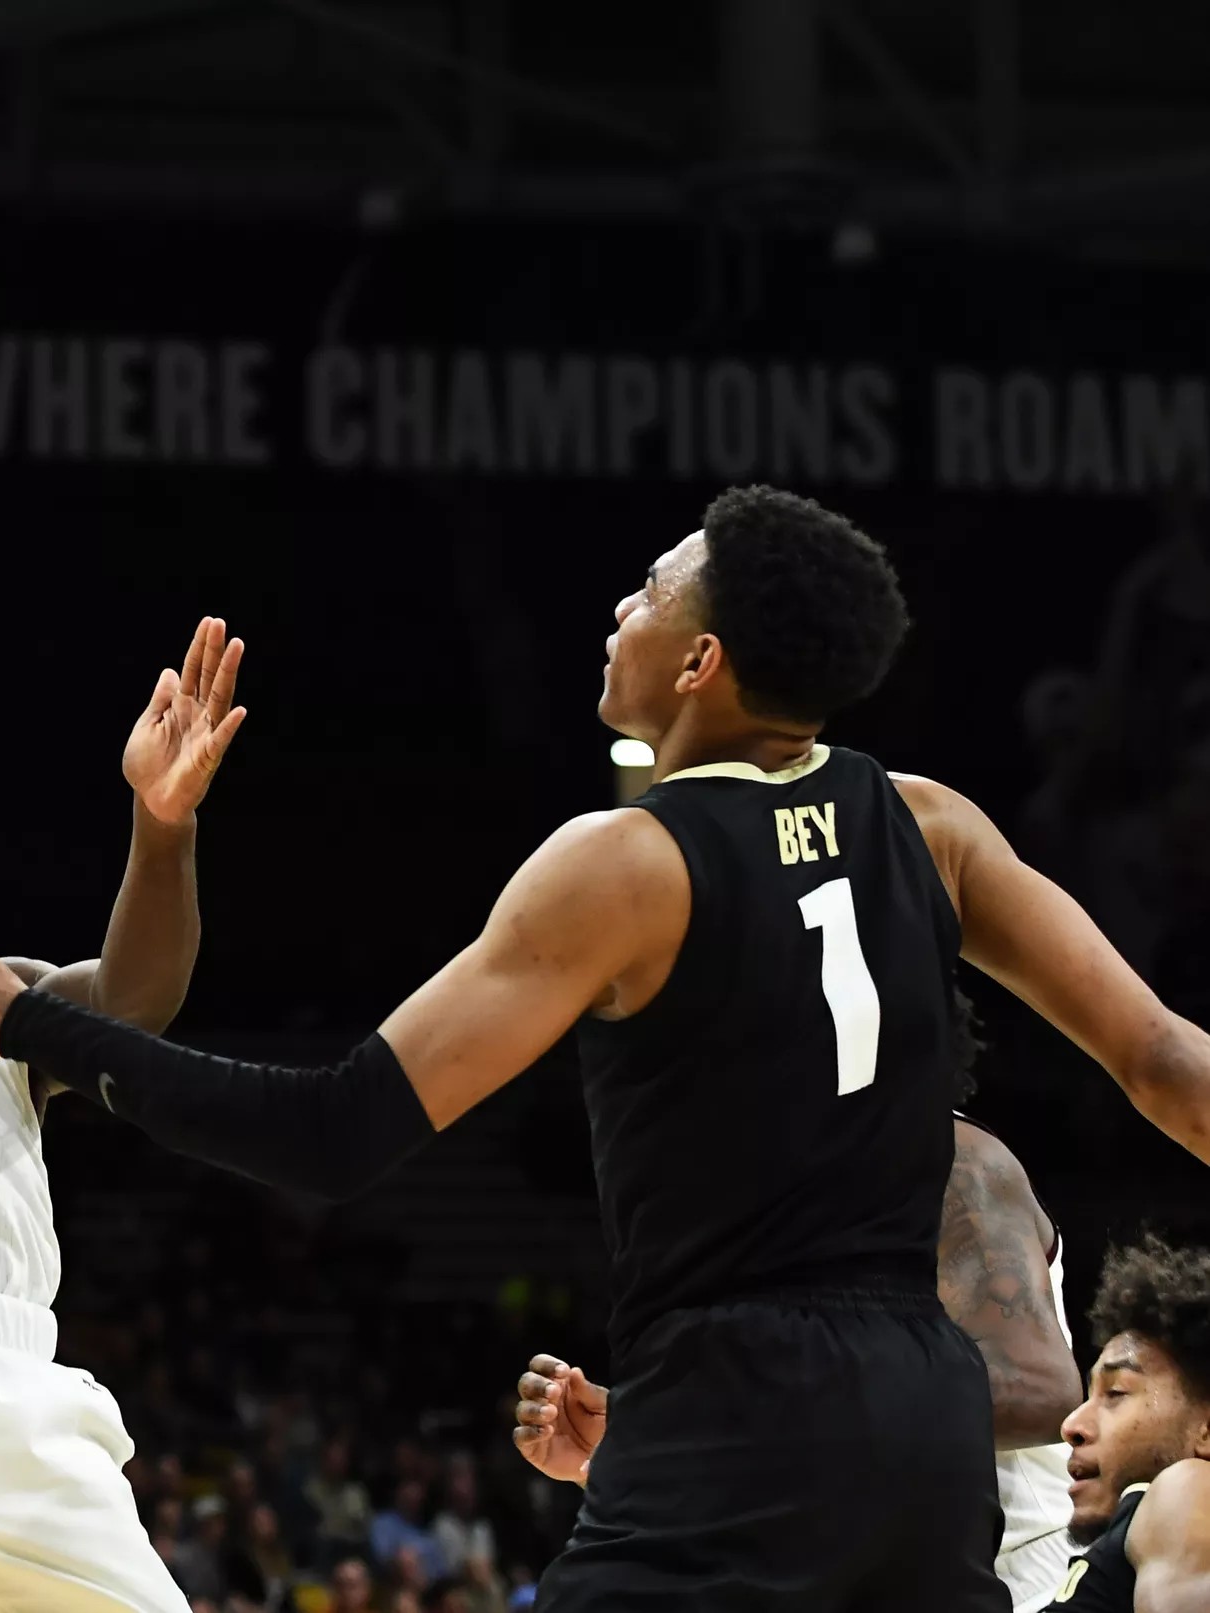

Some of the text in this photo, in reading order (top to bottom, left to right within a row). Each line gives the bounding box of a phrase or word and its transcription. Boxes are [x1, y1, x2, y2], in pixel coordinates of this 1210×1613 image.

[305, 345, 898, 486] CHAMPIONS
[936, 367, 1210, 494] ROAM
[774, 802, 840, 865] BEY
[797, 877, 881, 1096] 1
